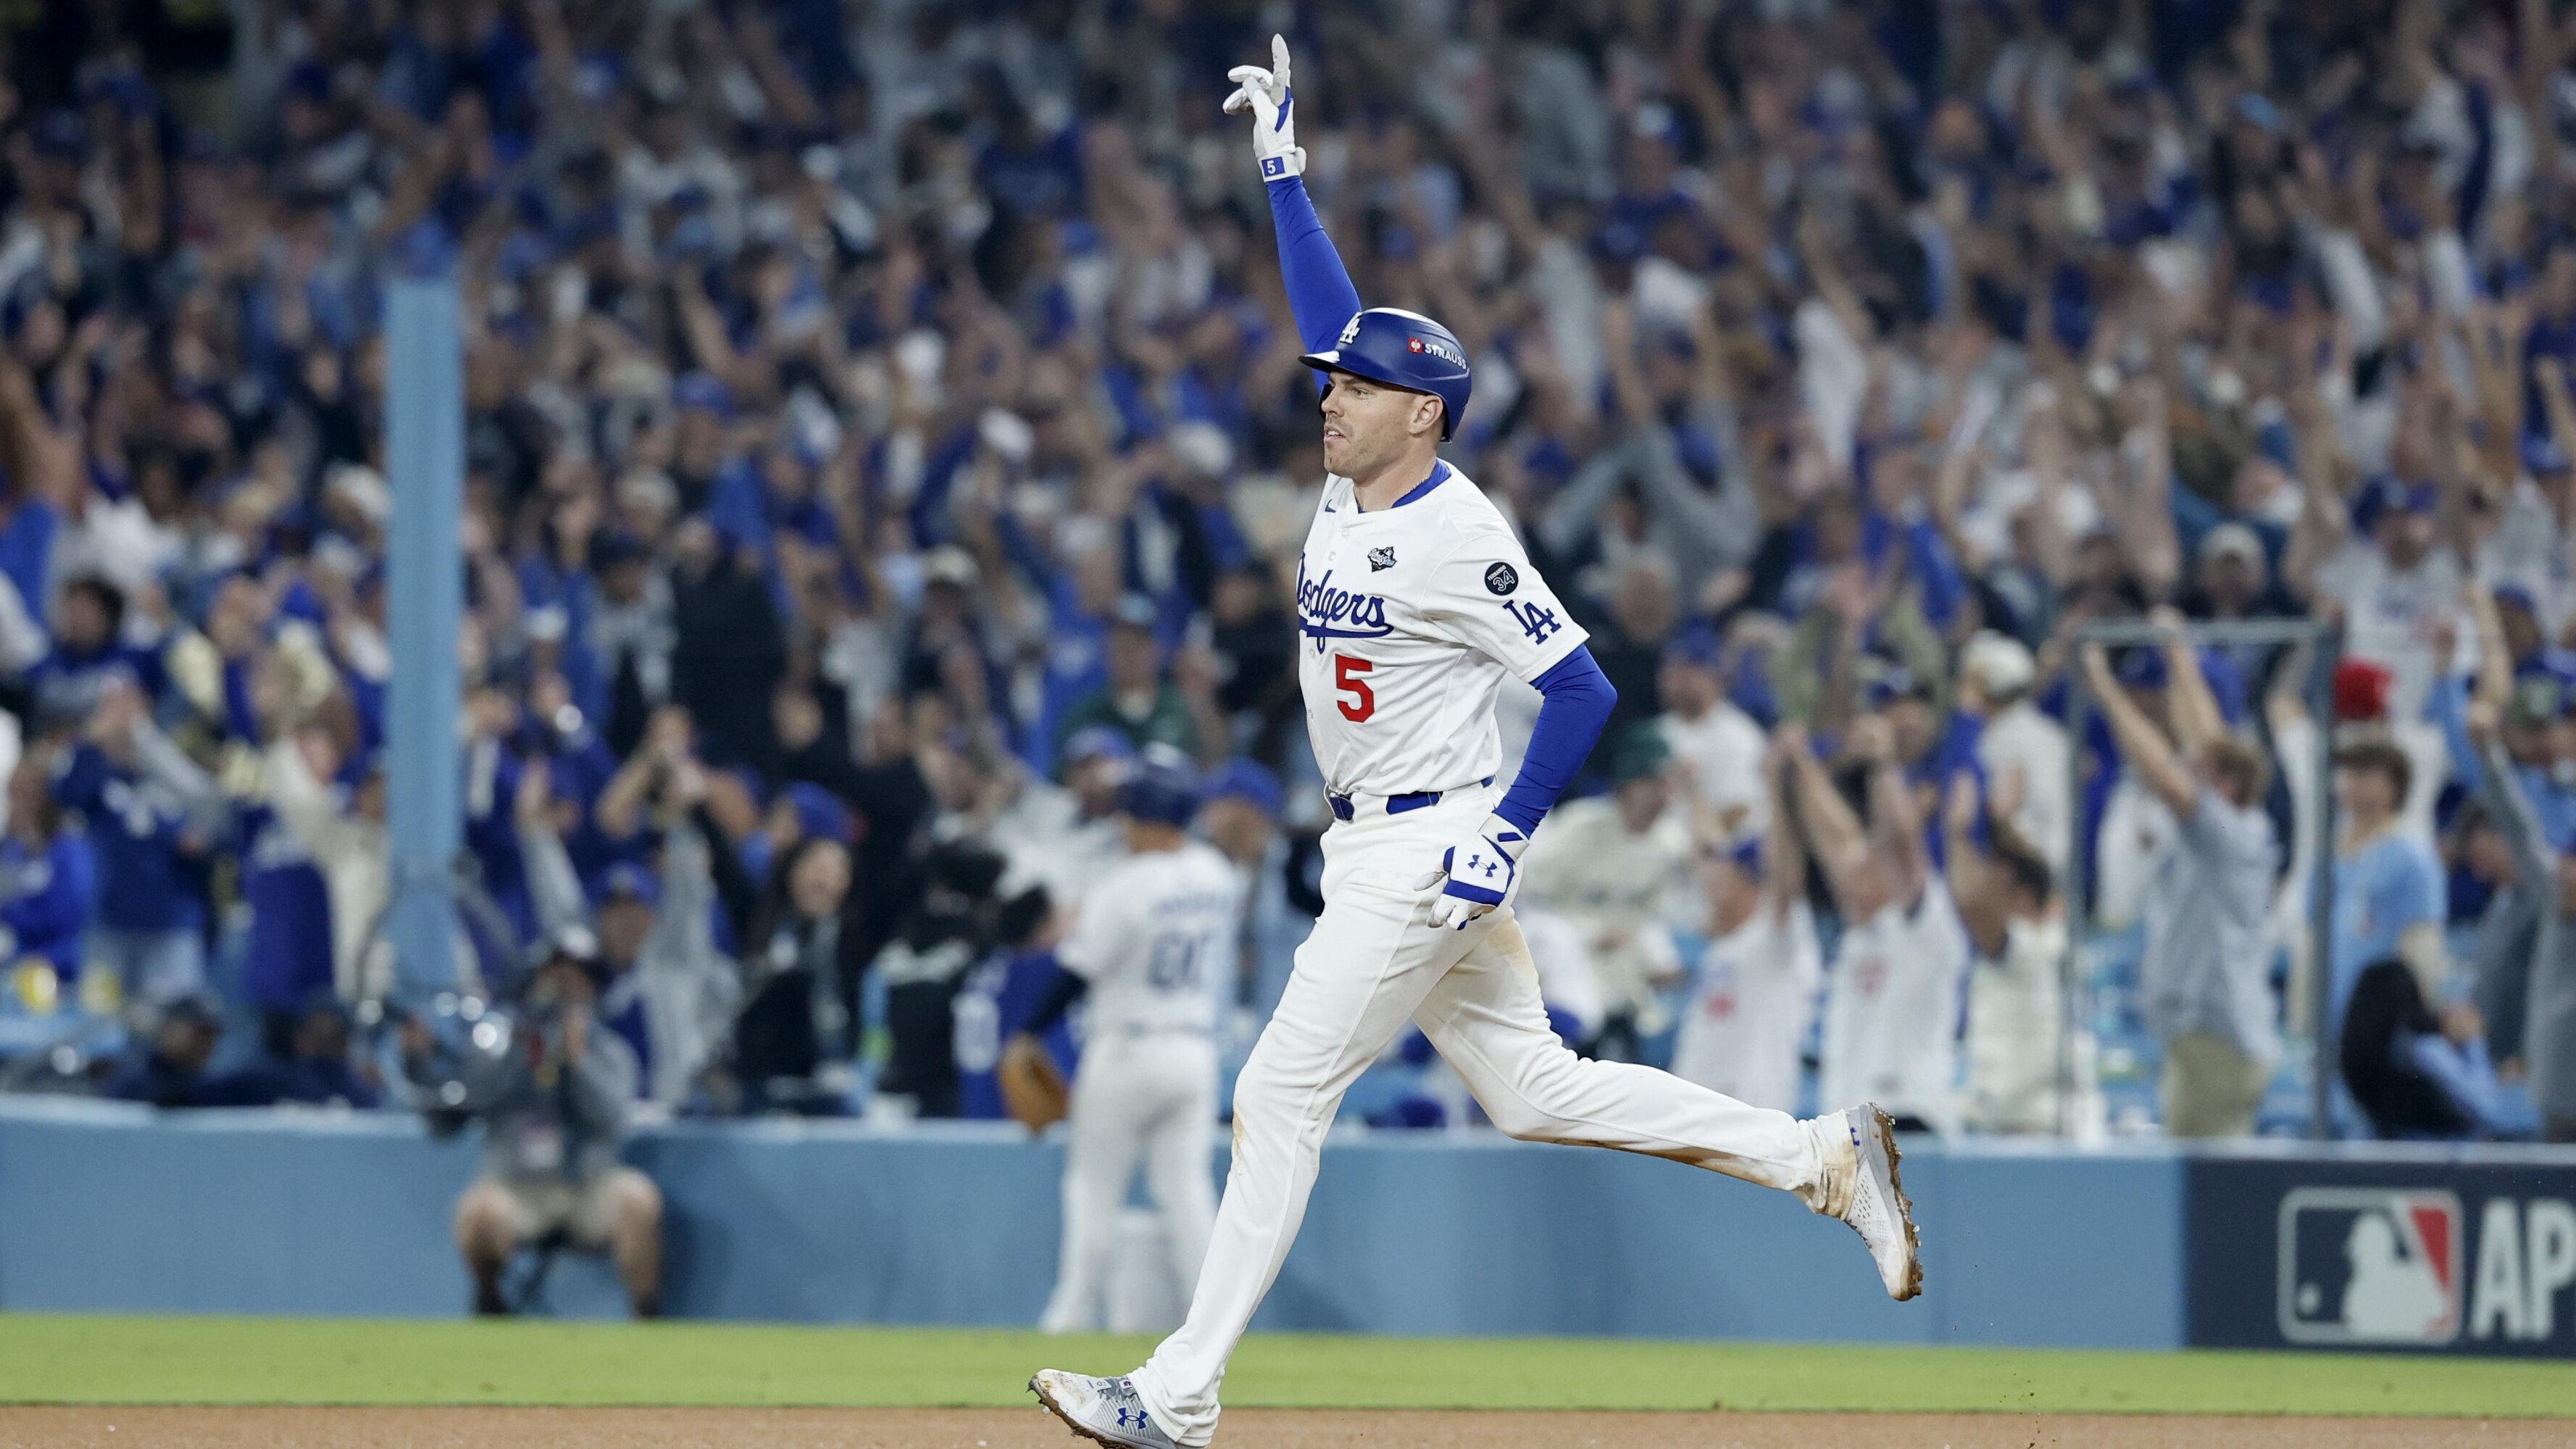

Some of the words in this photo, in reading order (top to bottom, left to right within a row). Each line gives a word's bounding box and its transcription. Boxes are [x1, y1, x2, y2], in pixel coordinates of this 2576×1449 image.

[1267, 160, 1276, 174] 5
[1425, 343, 1467, 369] STRAUSS
[1493, 569, 1515, 592] 34
[1502, 599, 1562, 646] LA
[1335, 653, 1375, 723] 5
